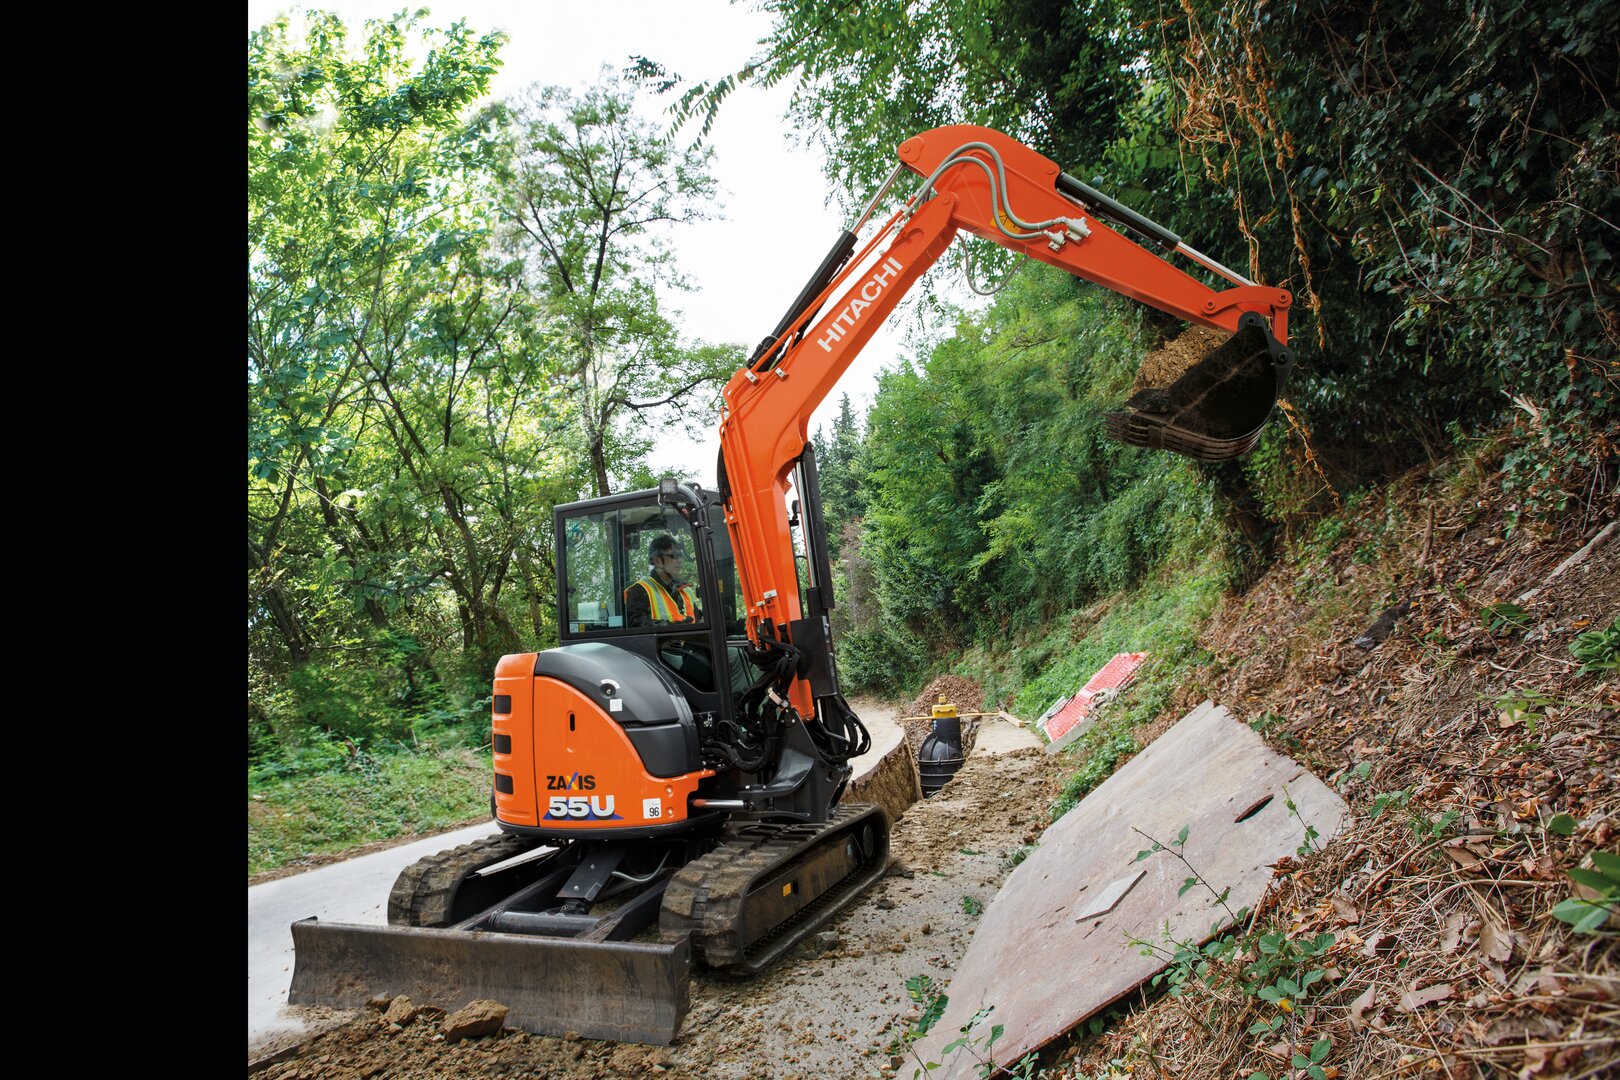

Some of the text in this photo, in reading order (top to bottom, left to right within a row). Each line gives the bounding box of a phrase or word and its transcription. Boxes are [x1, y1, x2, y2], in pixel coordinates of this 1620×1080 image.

[817, 256, 903, 353] HITACHI
[546, 772, 596, 791] ZAXIS
[549, 795, 615, 818] 55U
[649, 806, 660, 817] 96
